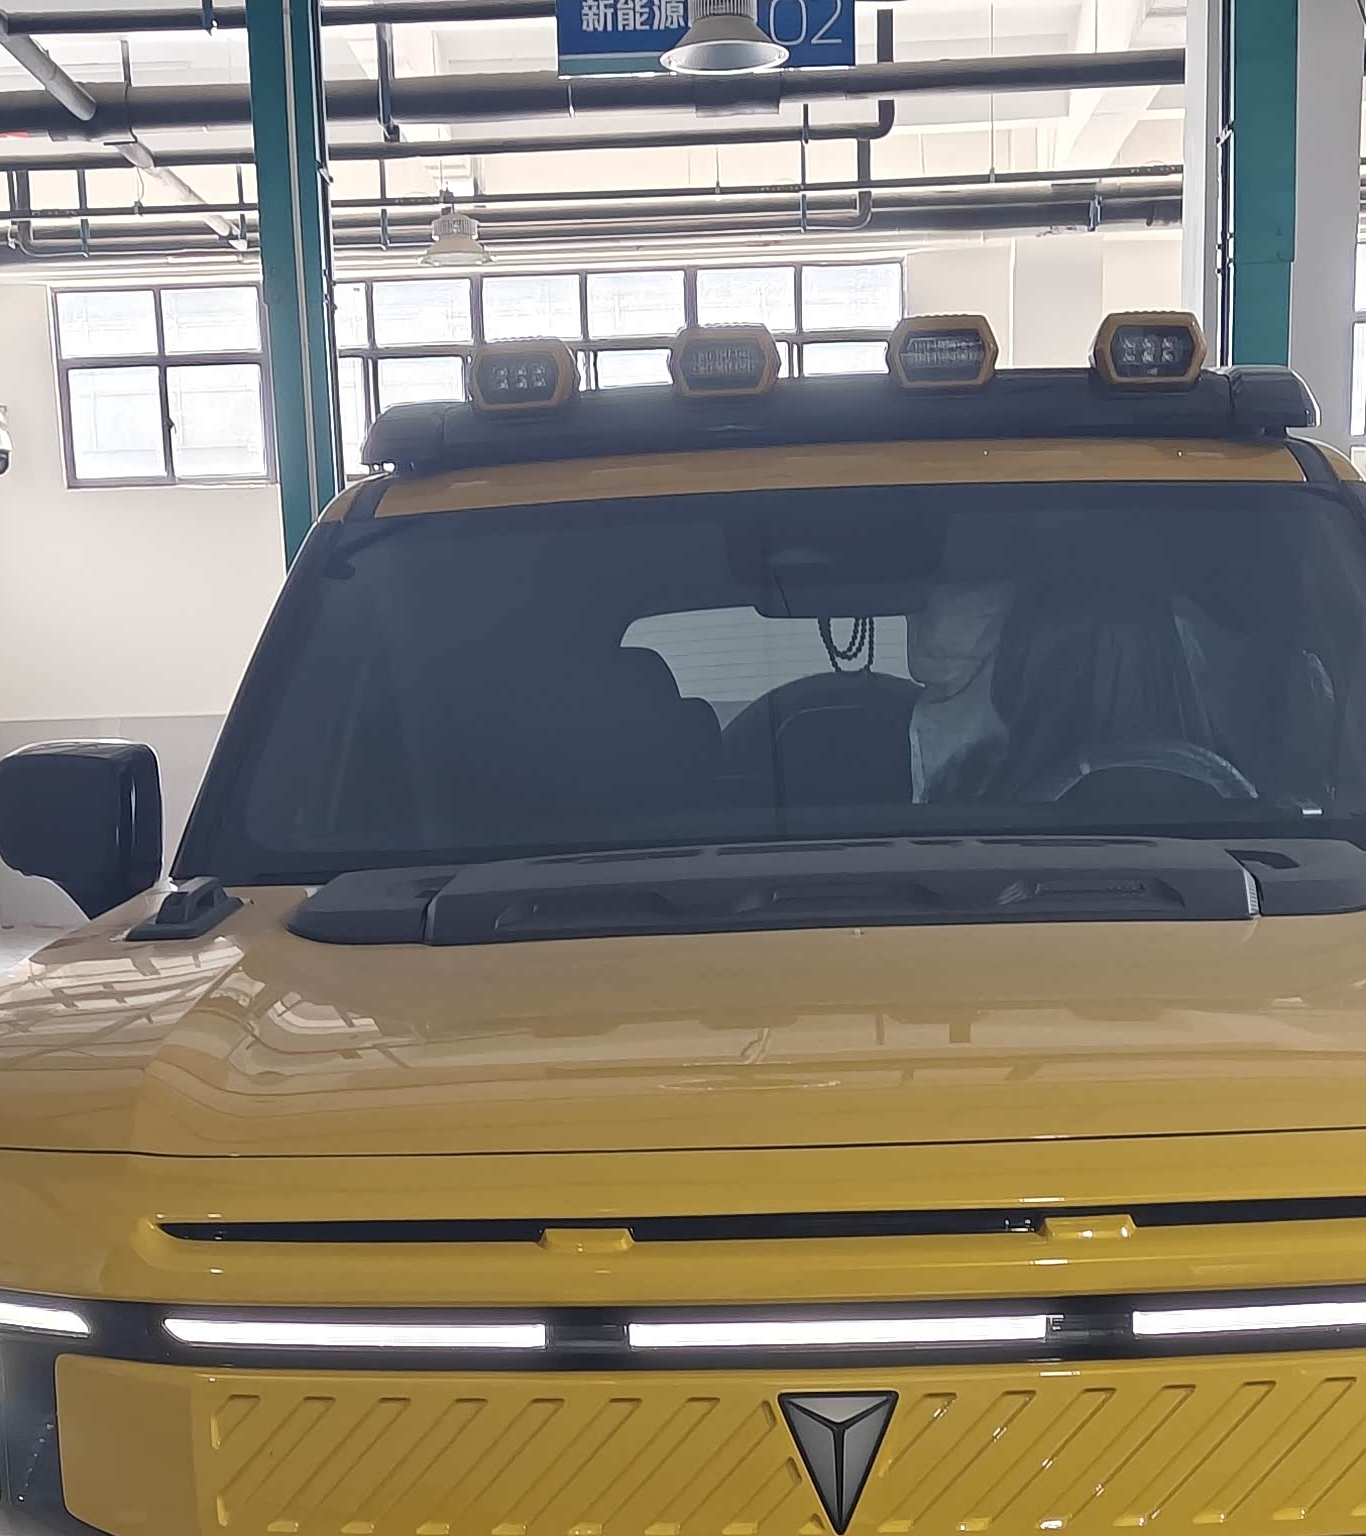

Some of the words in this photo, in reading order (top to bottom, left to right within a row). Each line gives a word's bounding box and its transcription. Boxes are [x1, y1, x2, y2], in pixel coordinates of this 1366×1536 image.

[581, 0, 686, 32] 新能源
[769, 0, 843, 46] 02
